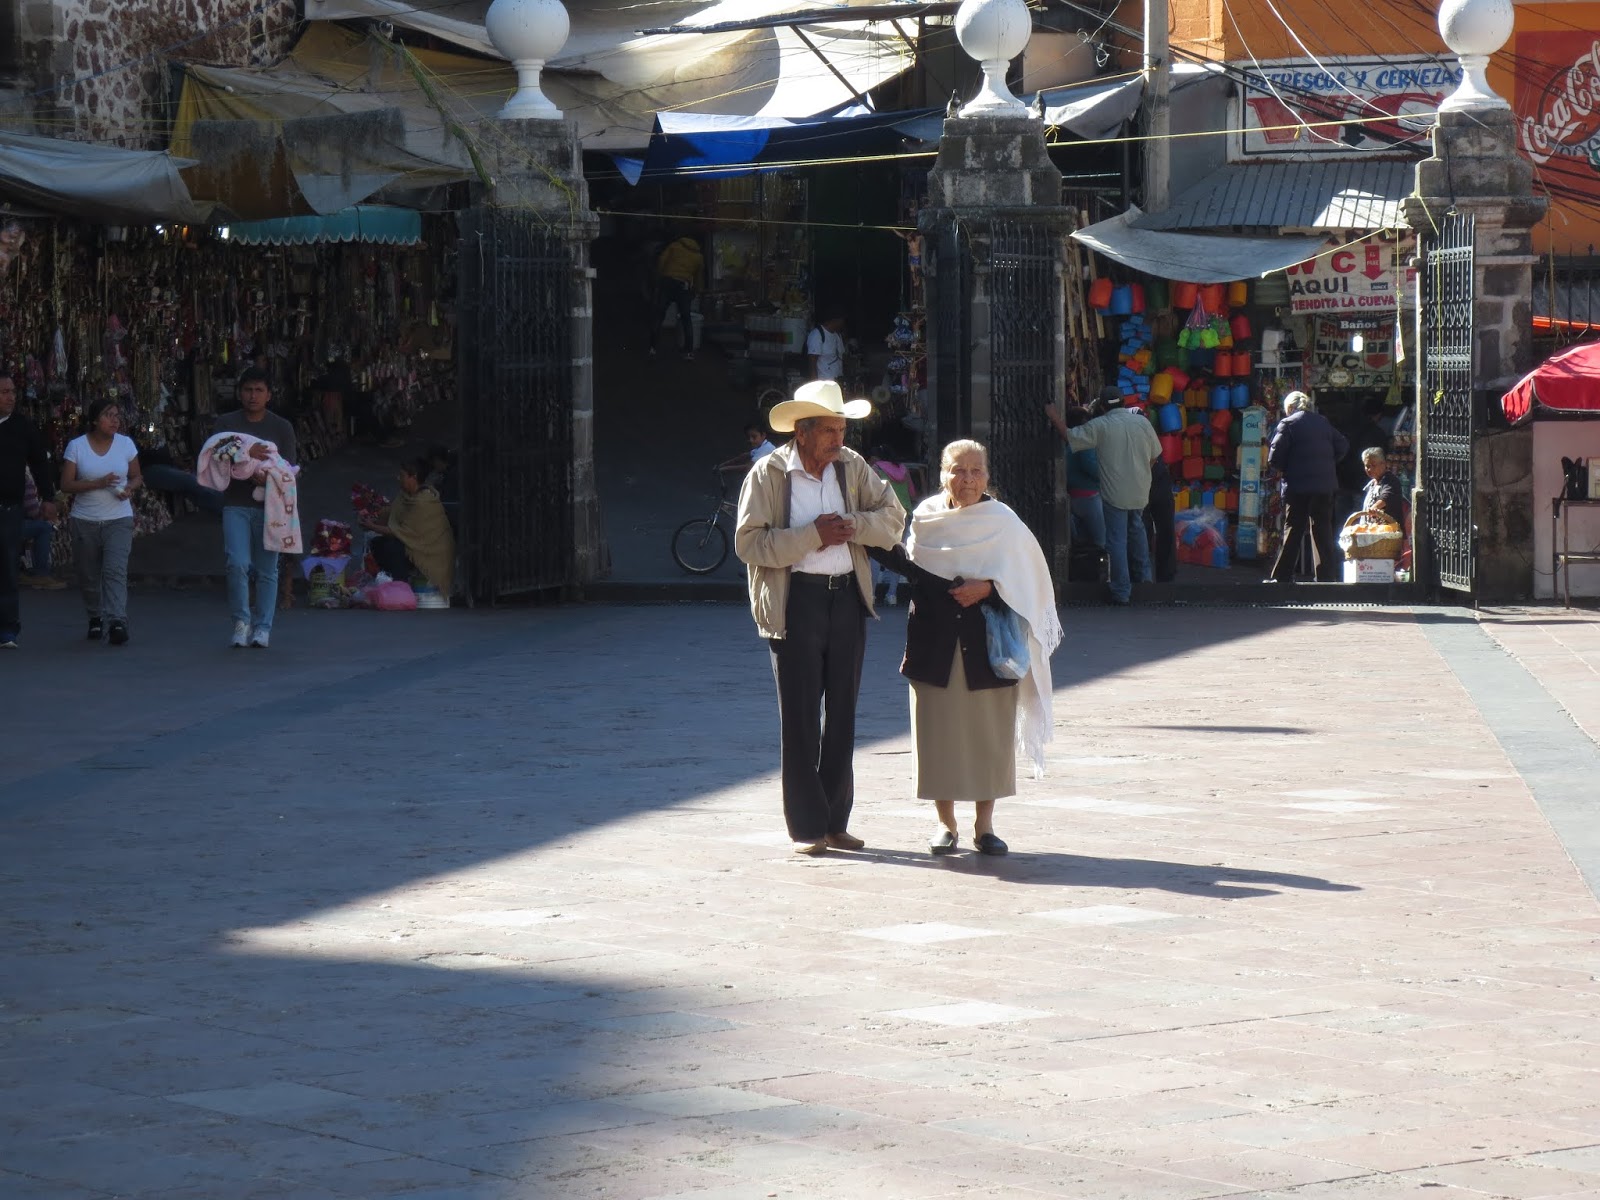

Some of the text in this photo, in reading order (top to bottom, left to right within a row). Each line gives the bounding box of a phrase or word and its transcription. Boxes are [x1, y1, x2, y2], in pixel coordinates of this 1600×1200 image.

[1248, 66, 1464, 94] REFRESCOS Y CERVEZAS
[1291, 277, 1349, 296] AQUI
[1342, 297, 1356, 307] LA
[1358, 295, 1396, 307] CUEVA
[1340, 320, 1377, 329] Baños
